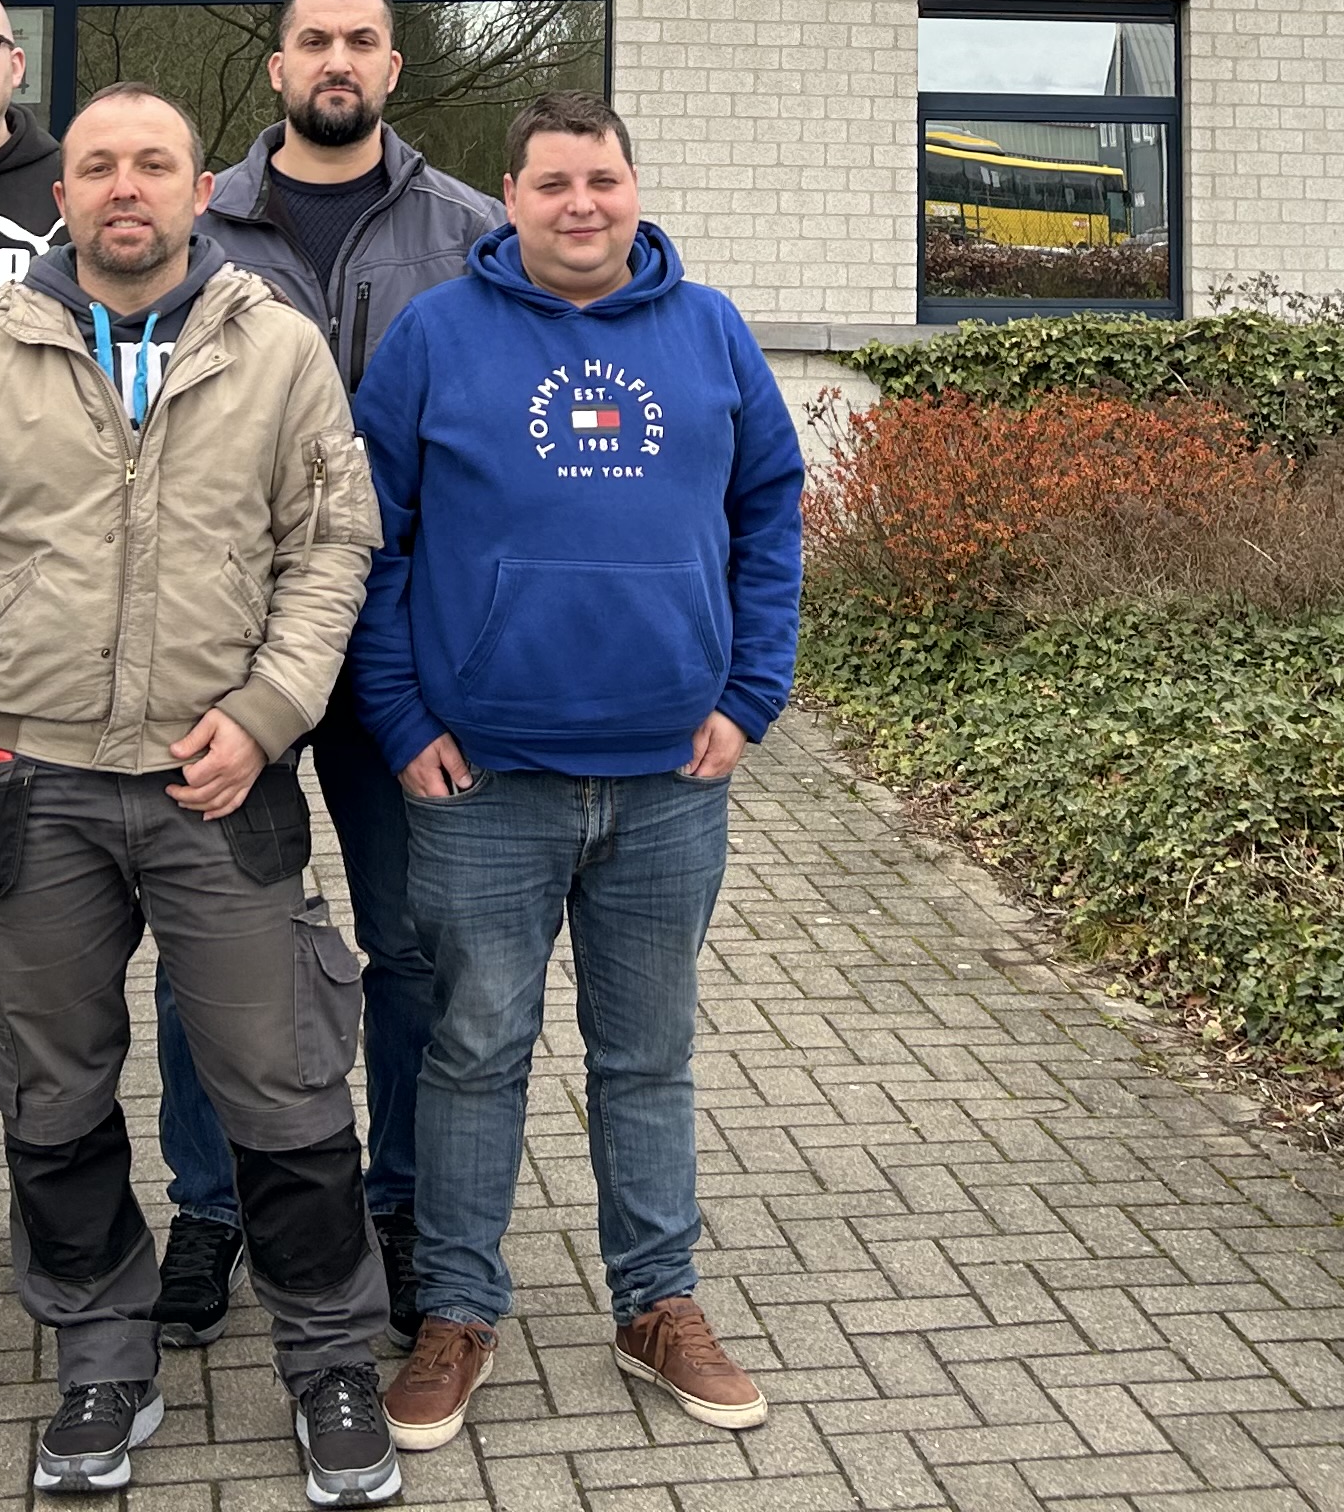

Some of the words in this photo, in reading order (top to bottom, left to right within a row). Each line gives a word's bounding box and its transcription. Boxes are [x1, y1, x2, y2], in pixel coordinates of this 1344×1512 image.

[574, 387, 614, 402] EST.
[529, 365, 570, 460] TOMMY
[584, 358, 664, 456] HILFIGER
[578, 437, 620, 453] 1985
[558, 466, 594, 478] NEW
[601, 466, 644, 478] YORK
